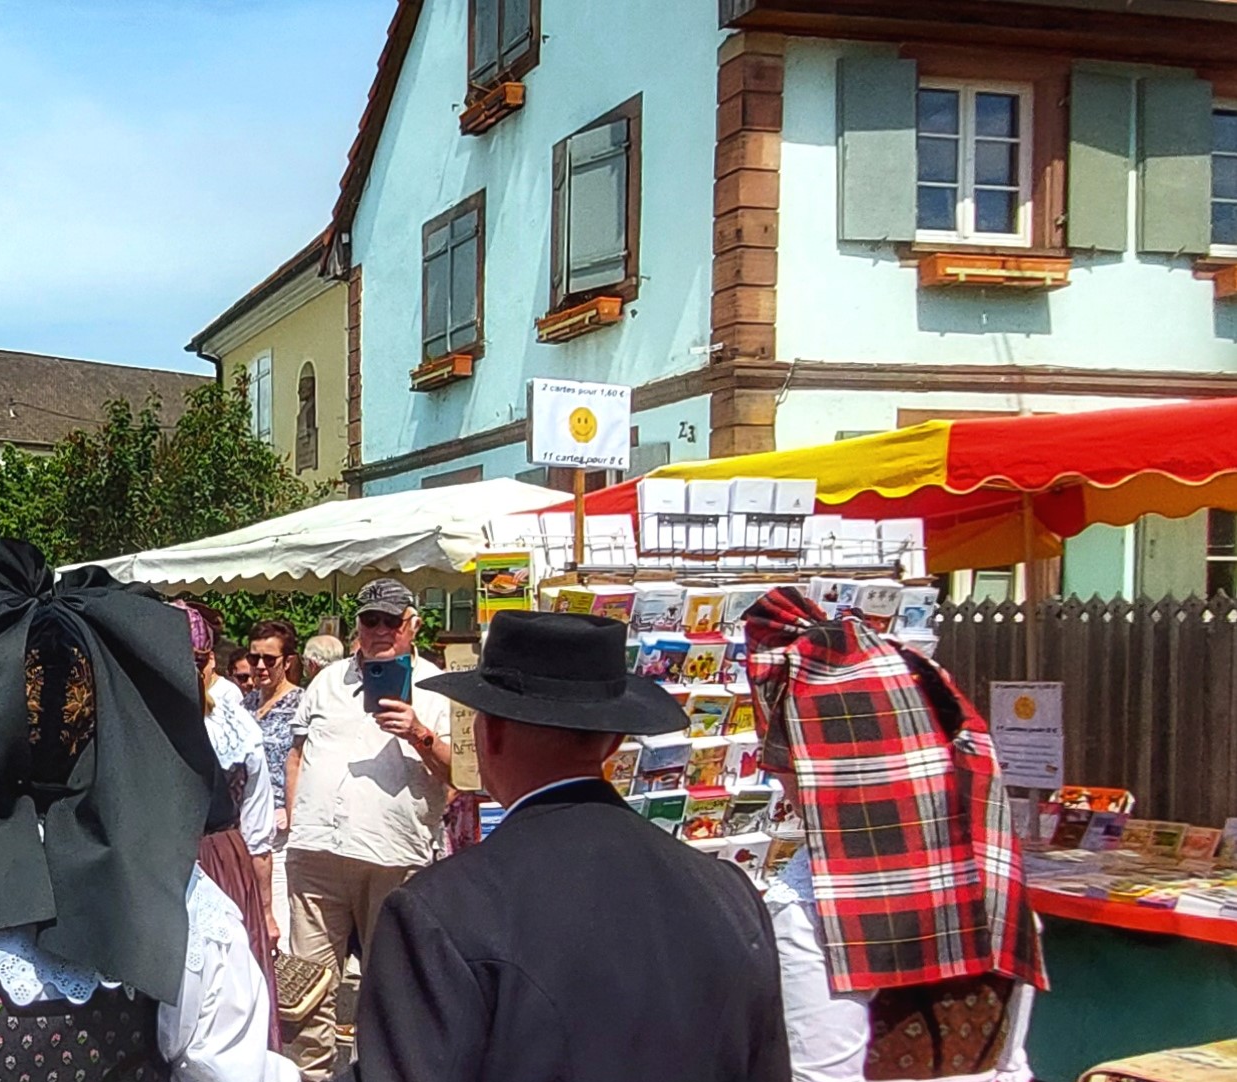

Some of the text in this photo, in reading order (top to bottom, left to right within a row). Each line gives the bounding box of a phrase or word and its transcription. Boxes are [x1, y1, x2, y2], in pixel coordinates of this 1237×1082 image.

[541, 383, 625, 398] 2 cartes pour 1,60 €
[543, 452, 553, 460] 11
[555, 454, 584, 464] cartes
[585, 456, 608, 465] pour
[609, 457, 616, 465] 8
